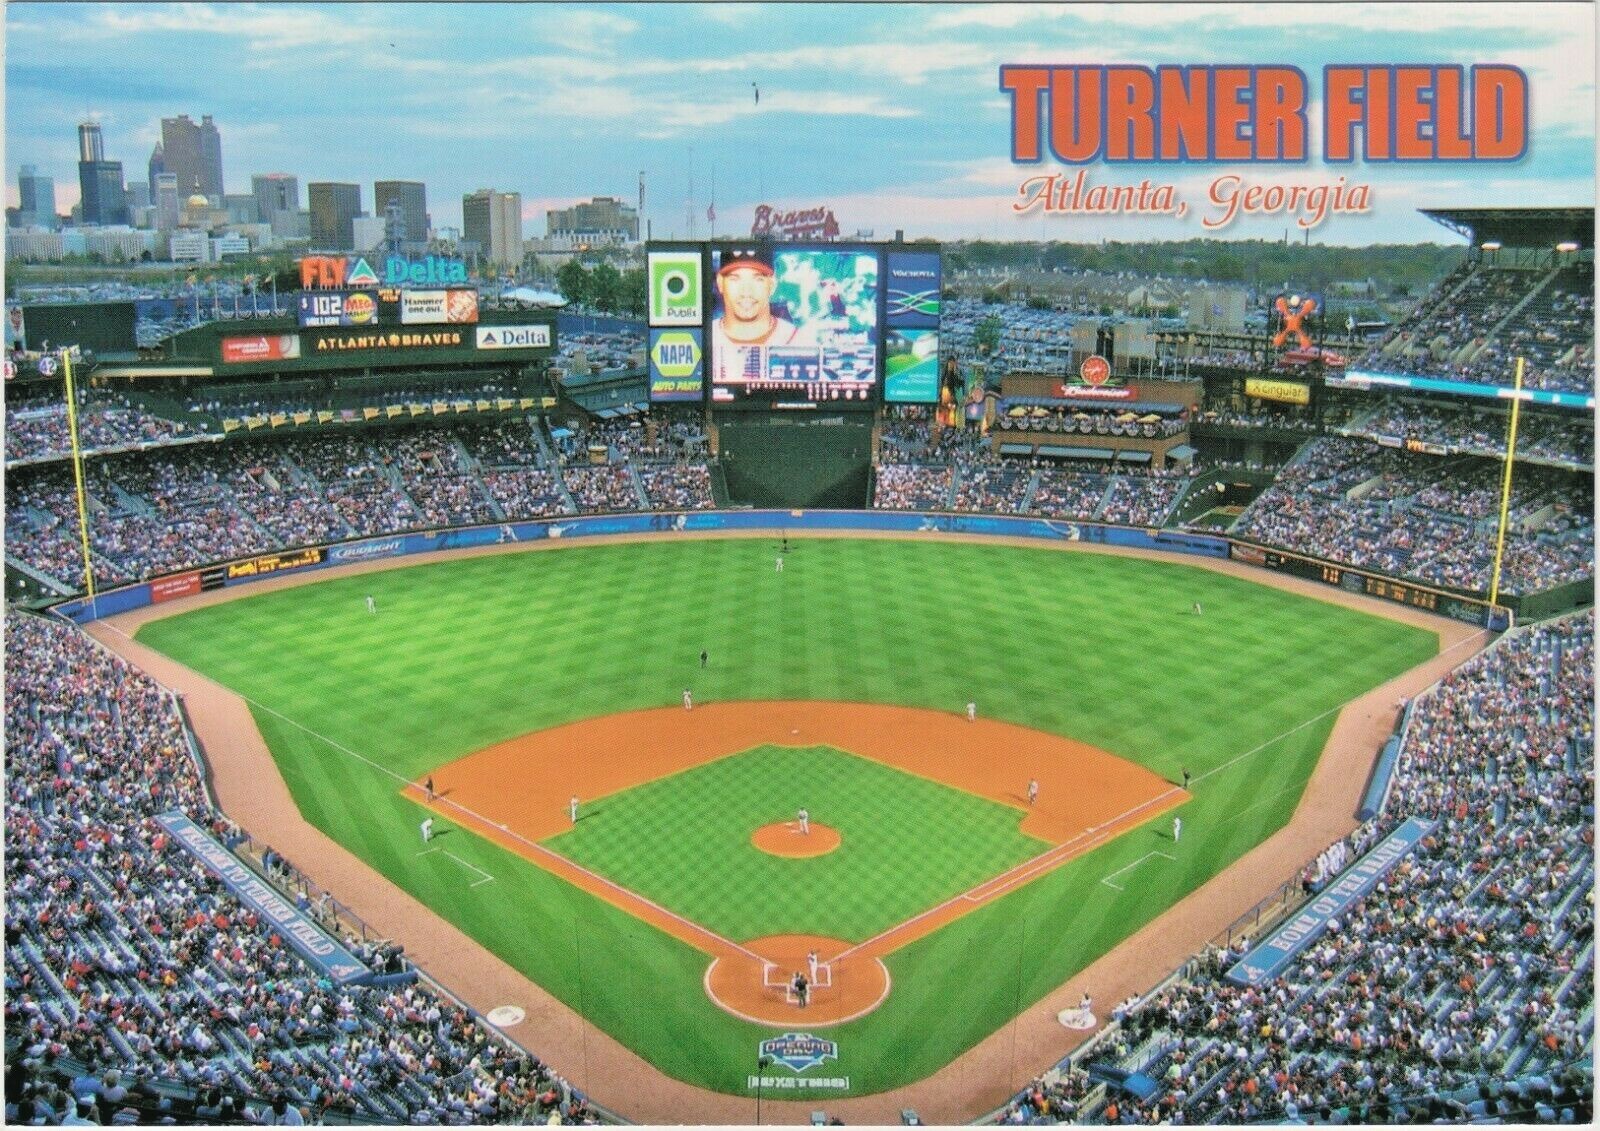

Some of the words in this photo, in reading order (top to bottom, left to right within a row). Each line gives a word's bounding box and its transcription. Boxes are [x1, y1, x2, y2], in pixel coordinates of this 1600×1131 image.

[752, 204, 825, 234] Braves
[300, 257, 346, 286] FLY
[385, 256, 468, 284] Delta
[892, 269, 936, 278] WACHOVIA
[313, 296, 341, 316] 102
[405, 298, 443, 307] Hammer
[667, 308, 697, 318] Publix
[318, 335, 387, 350] ATLANTA
[402, 333, 461, 347] BRAVES
[502, 329, 547, 347] Delta
[660, 344, 694, 365] NAPA
[1262, 385, 1302, 397] cingular
[222, 867, 250, 882] TO
[240, 880, 297, 923] TURNER
[286, 919, 335, 955] FIELD
[1268, 913, 1321, 951] HOME
[1311, 896, 1340, 915] OF
[1330, 873, 1369, 897] THE
